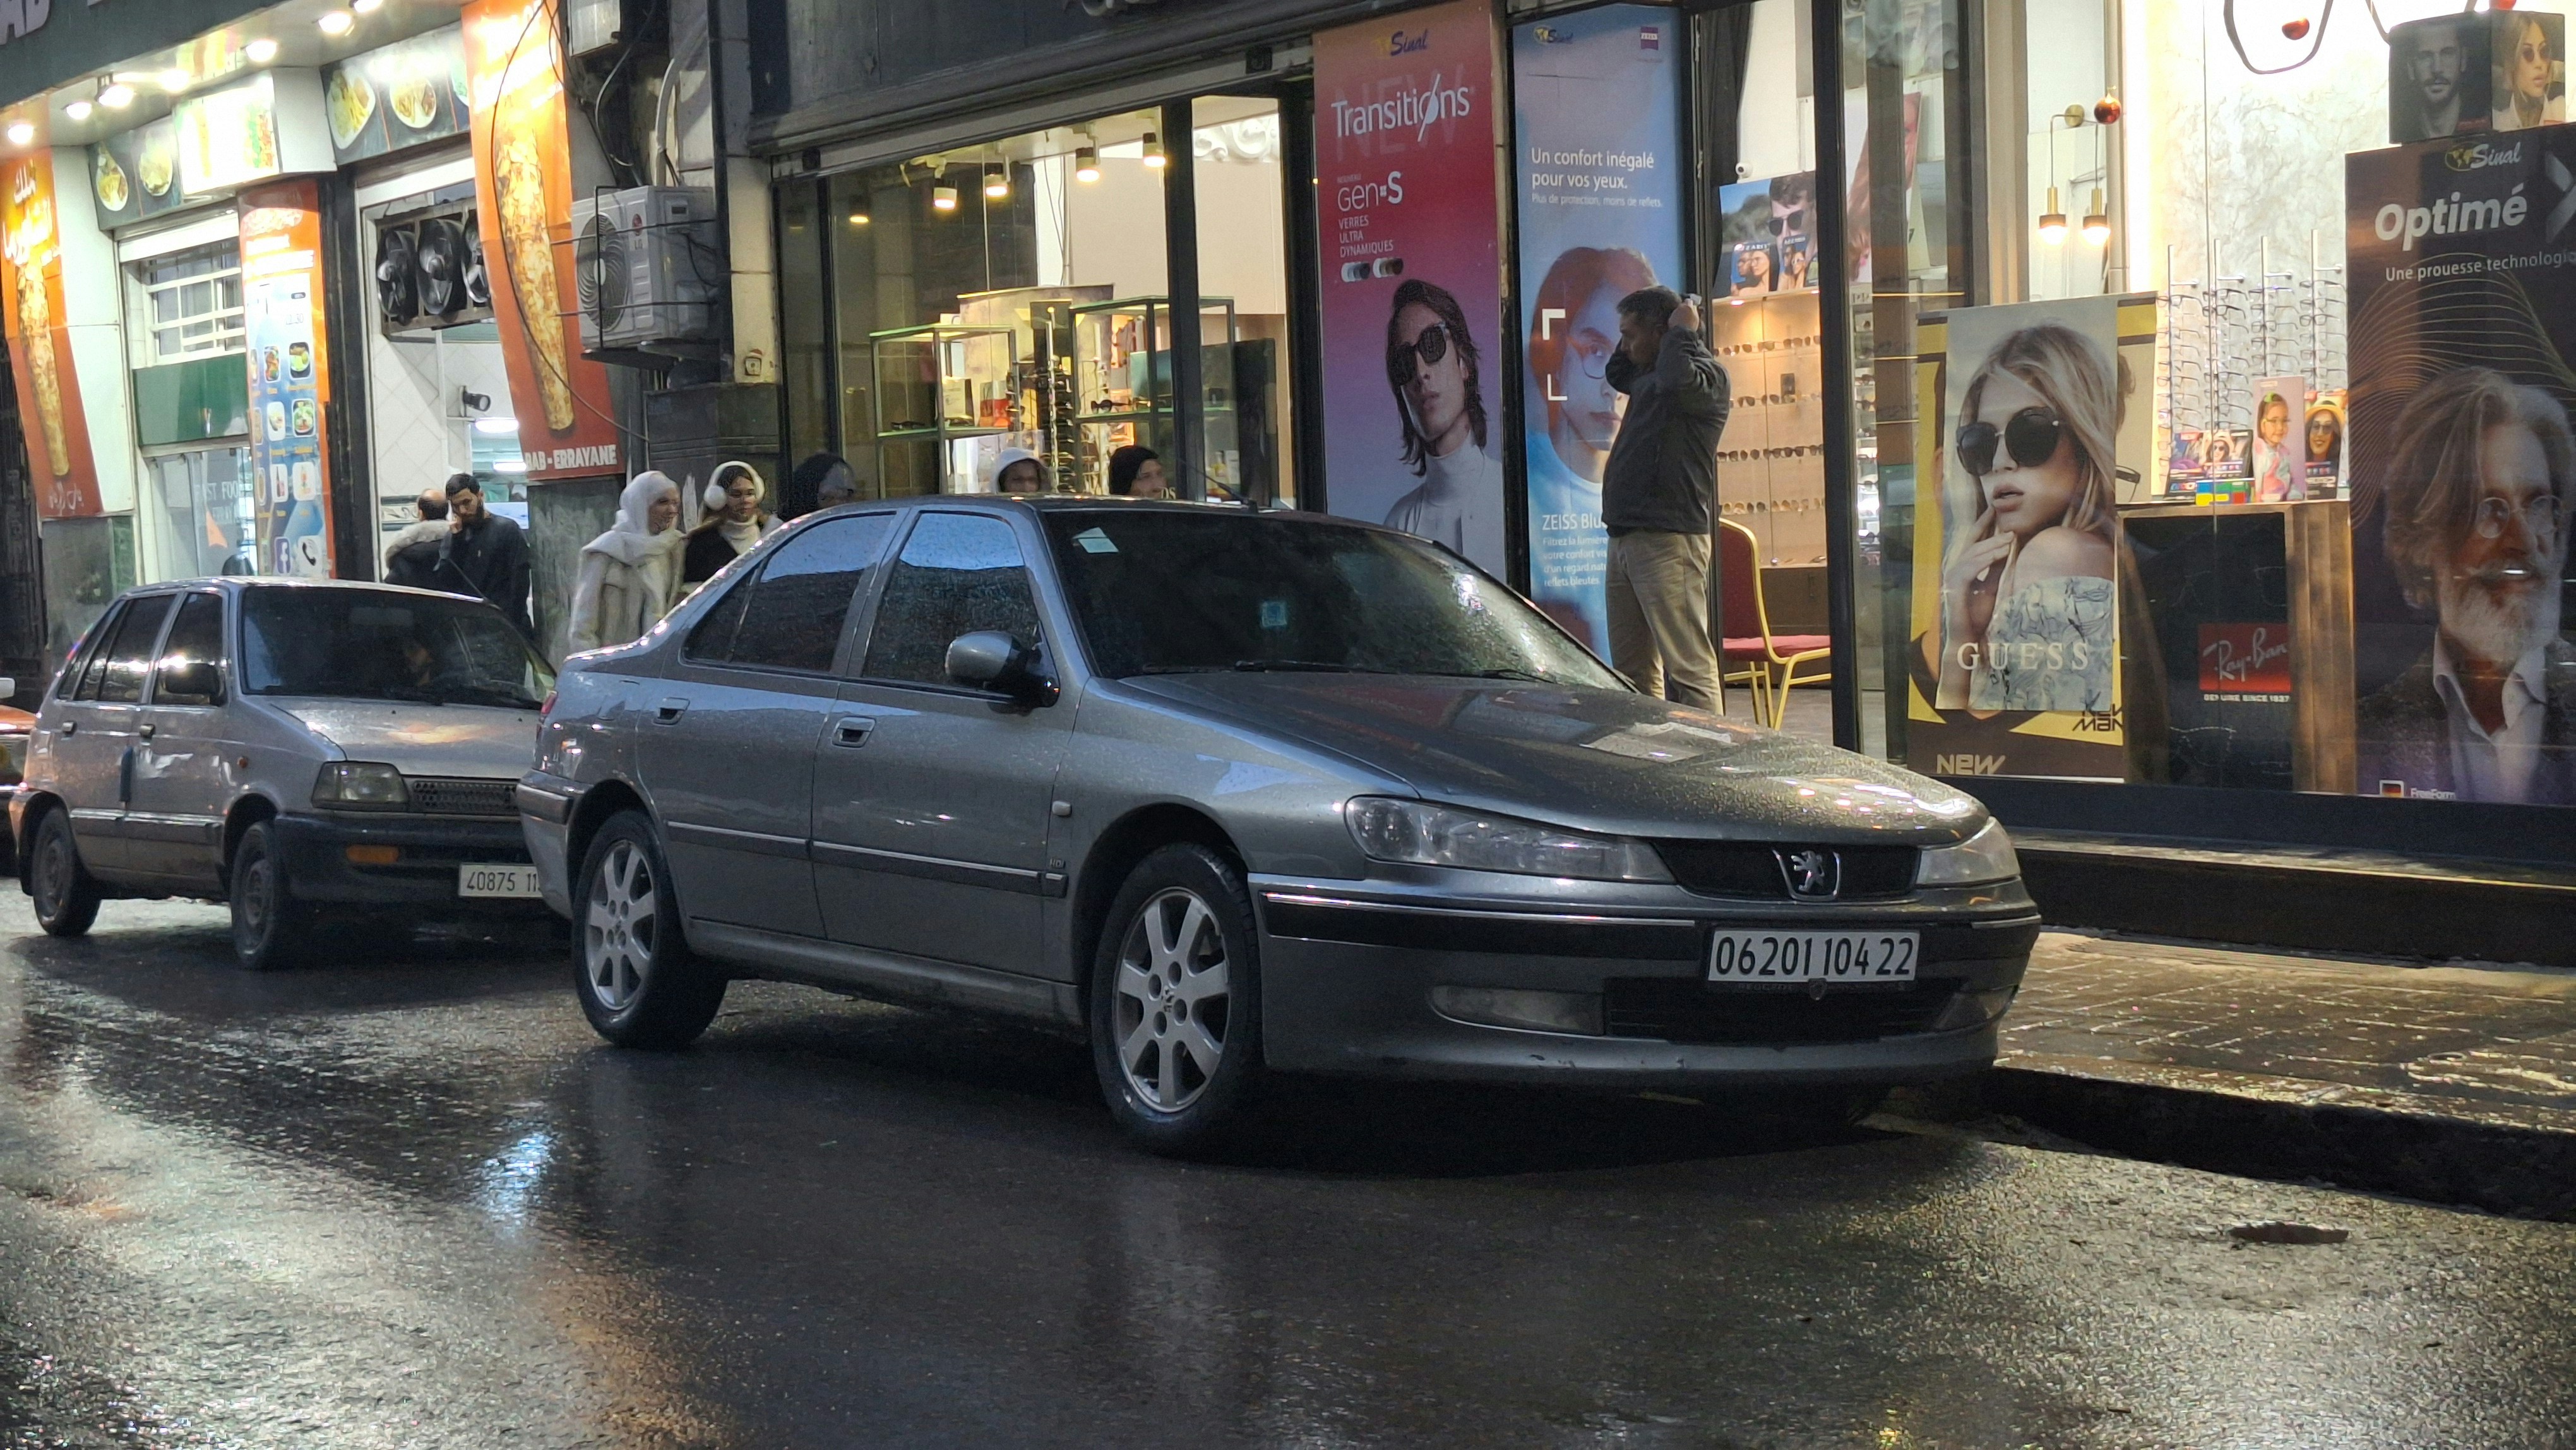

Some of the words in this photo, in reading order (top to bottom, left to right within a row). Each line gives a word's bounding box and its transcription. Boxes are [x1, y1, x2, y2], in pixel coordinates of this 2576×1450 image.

[1331, 73, 1470, 142] Transitions
[1531, 147, 1551, 164] Un
[1554, 149, 1603, 166] confort
[1606, 150, 1654, 172] inégalé
[2470, 141, 2521, 169] Sinal
[1532, 172, 1564, 189] pour
[1567, 174, 1590, 188] vos
[1593, 176, 1628, 192] yeux.
[1532, 193, 1546, 203] Plus
[1548, 194, 1558, 204] de
[1627, 196, 1637, 207] de
[1339, 214, 1369, 230] VERRES
[2375, 183, 2527, 251] Optimé
[1339, 230, 1364, 244] ULTRA
[1340, 239, 1394, 258] DYNAMIQUES
[2385, 267, 2413, 282] Une
[2418, 259, 2483, 281] prouesse
[1542, 513, 1578, 530] ZEISS
[1957, 642, 2089, 671] GUESS
[466, 871, 516, 892] 40875
[1715, 937, 1813, 976] 06201
[1823, 938, 1869, 976] 104
[1876, 938, 1914, 976] 22
